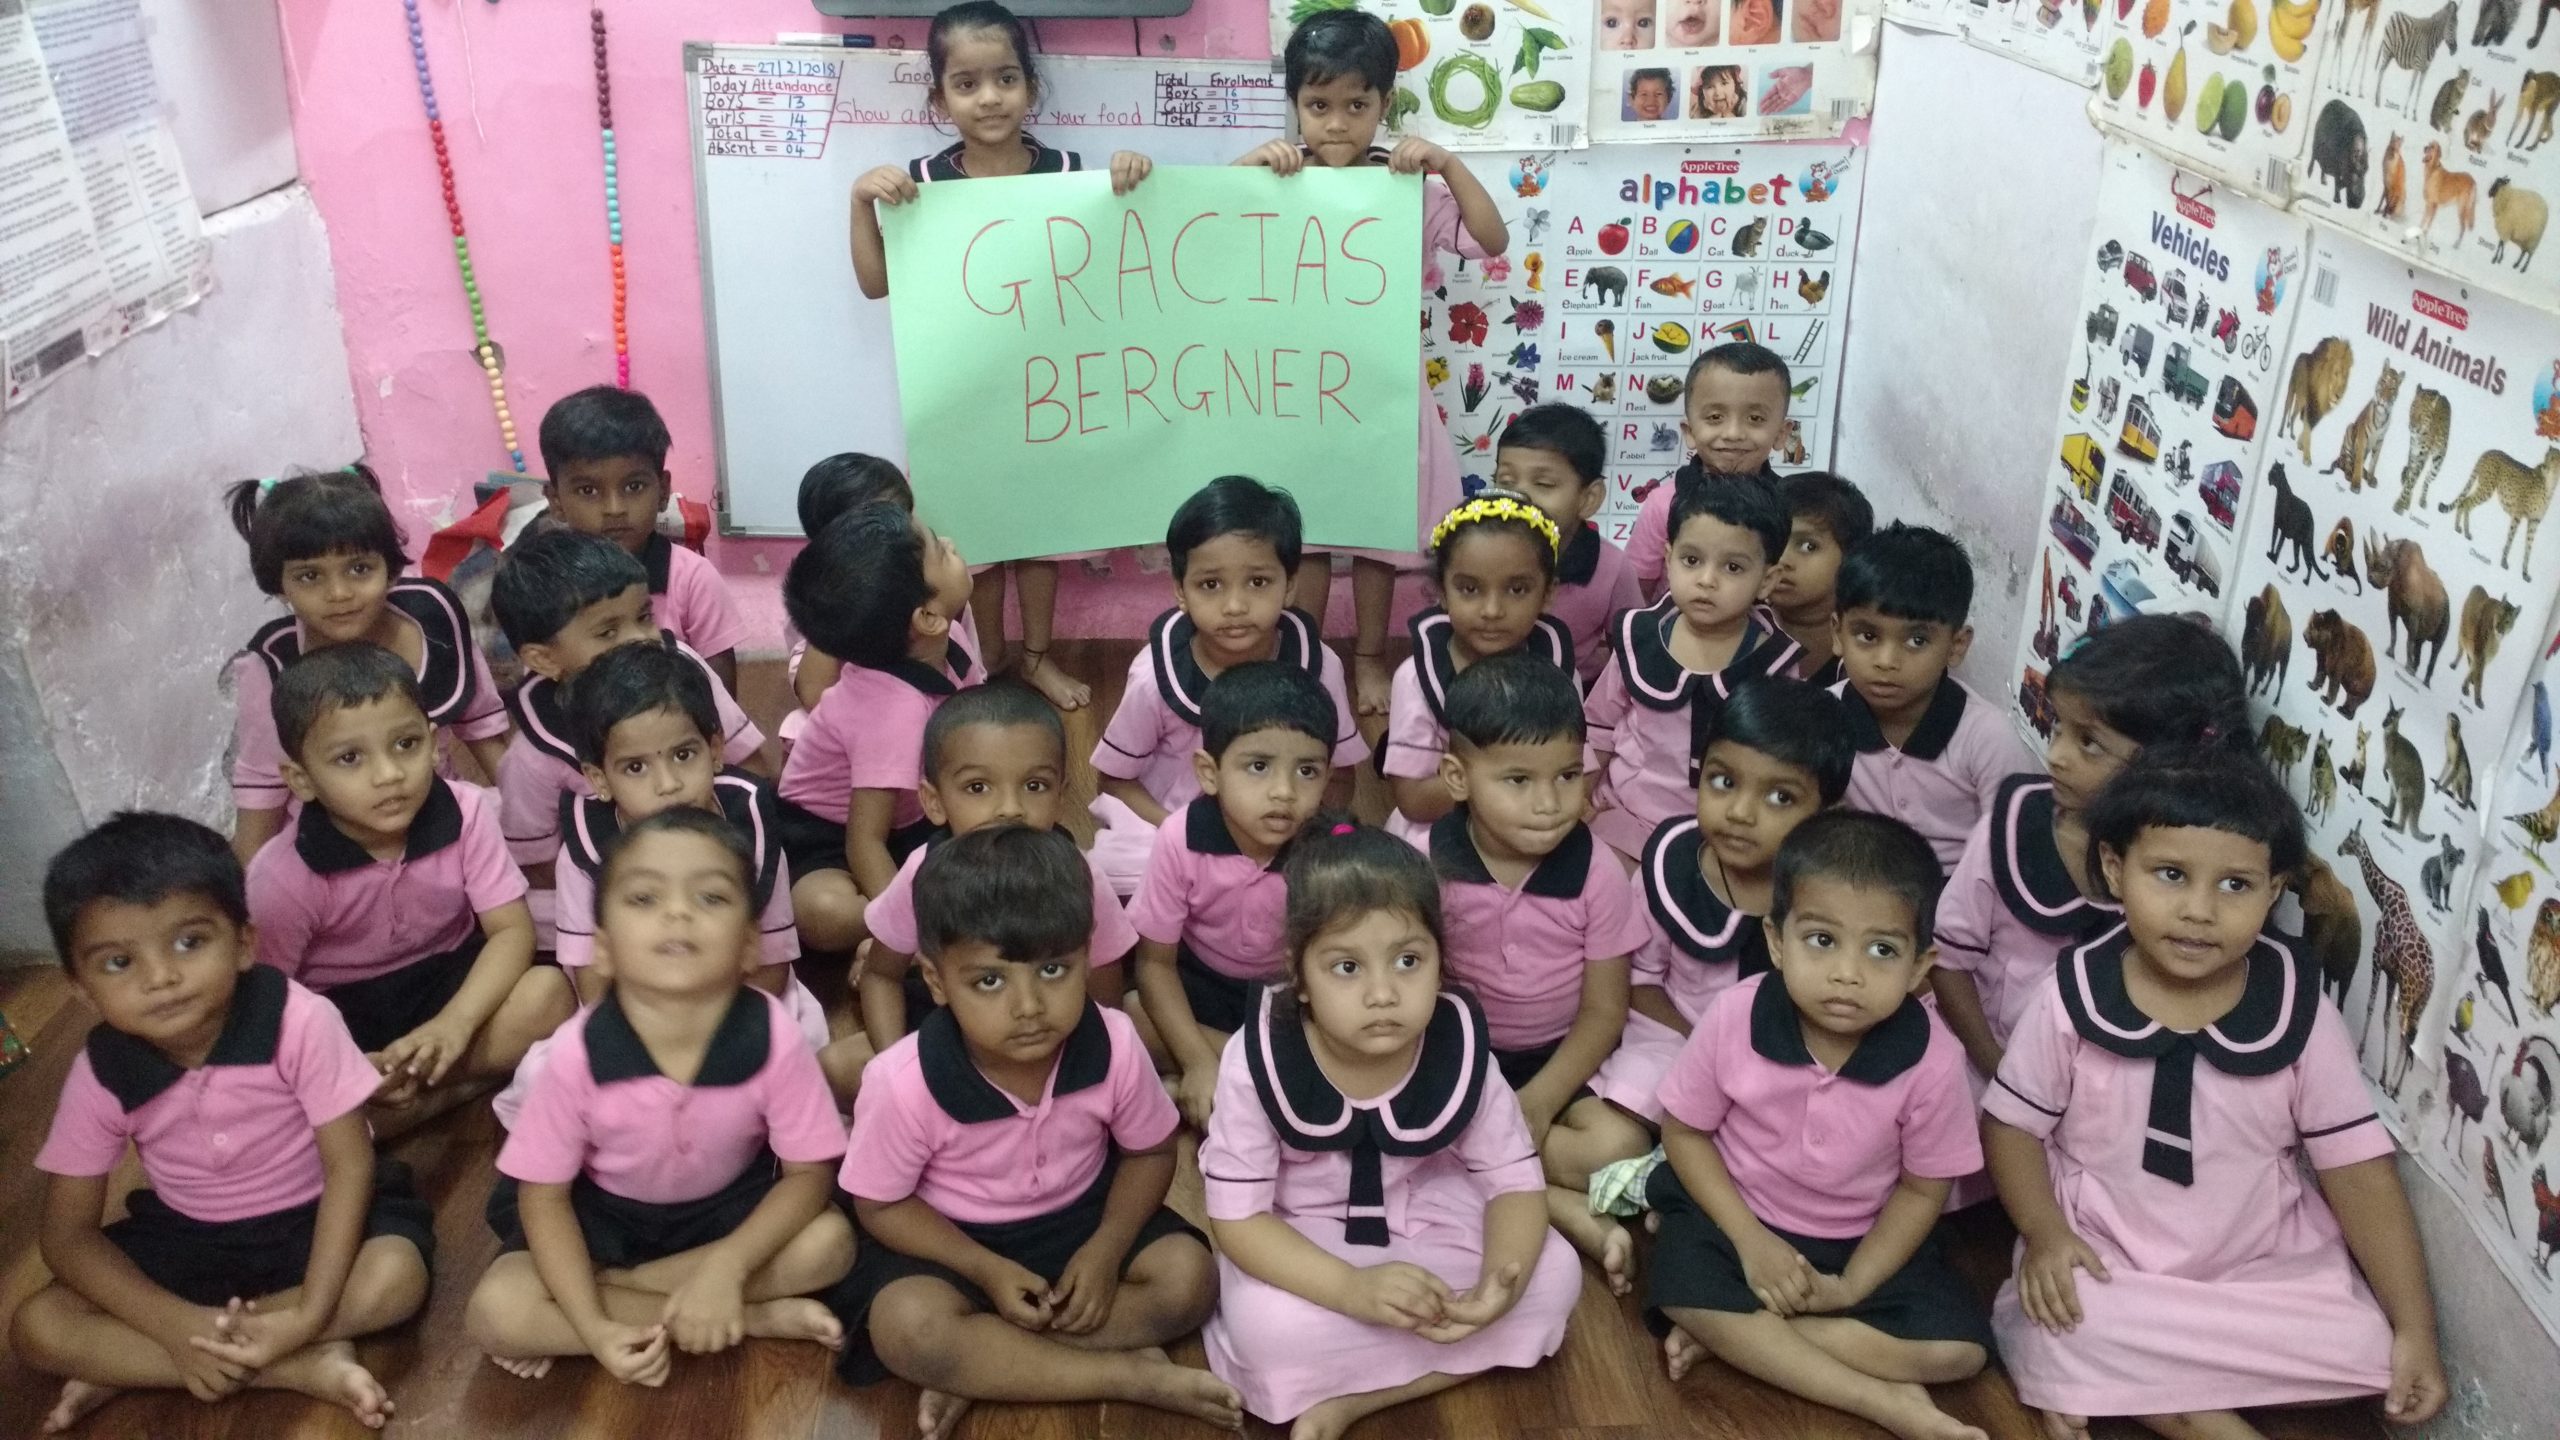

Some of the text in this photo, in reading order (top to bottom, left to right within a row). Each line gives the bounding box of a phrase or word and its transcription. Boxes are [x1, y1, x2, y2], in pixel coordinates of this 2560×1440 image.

[702, 58, 738, 74] Date
[703, 75, 747, 95] Today
[1158, 72, 1188, 87] Total
[705, 92, 745, 109] Boys
[788, 95, 806, 109] 13
[1165, 86, 1198, 100] Boys
[1225, 87, 1238, 97] 16
[836, 98, 890, 123] Show
[1098, 102, 1143, 125] food
[1225, 99, 1240, 111] 15
[705, 110, 746, 127] Girls
[790, 113, 807, 128] 14
[1161, 111, 1198, 126] Total
[1222, 114, 1237, 127] 31
[711, 126, 749, 141] Total
[786, 130, 806, 143] 27
[708, 140, 758, 156] Absent
[786, 144, 805, 158] 04
[1681, 161, 1740, 173] AppleTree
[1619, 173, 1792, 211] alphabet
[1568, 216, 1584, 234] A
[1642, 216, 1658, 234] B
[1710, 217, 1727, 235] C
[1778, 217, 1794, 235] D
[1566, 244, 1592, 256] apple
[1639, 243, 1658, 256] ball
[1776, 244, 1799, 257] duck
[2151, 210, 2231, 282] Vehicles
[962, 208, 1388, 331] GRACIAS
[1565, 269, 1579, 287] E
[1638, 269, 1651, 287] F
[1705, 270, 1723, 288] G
[1773, 270, 1789, 288] H
[1562, 298, 1598, 309] elephant
[1635, 296, 1652, 309] fish
[1703, 298, 1725, 312] goat
[1770, 297, 1789, 309] hen
[2413, 291, 2469, 327] AppleTree
[1560, 321, 1566, 339] I
[1632, 321, 1645, 339] J
[1701, 322, 1716, 340] K
[1768, 322, 1781, 340] L
[2366, 301, 2507, 396] Wild Animals
[1556, 373, 1575, 390] M
[1628, 374, 1645, 391] N
[1025, 343, 1362, 444] BERGNER
[1625, 402, 1647, 412] nest
[1623, 423, 1638, 440] R
[1619, 450, 1646, 460] rabbit
[1618, 473, 1633, 491] V
[1612, 523, 1629, 540] Z
